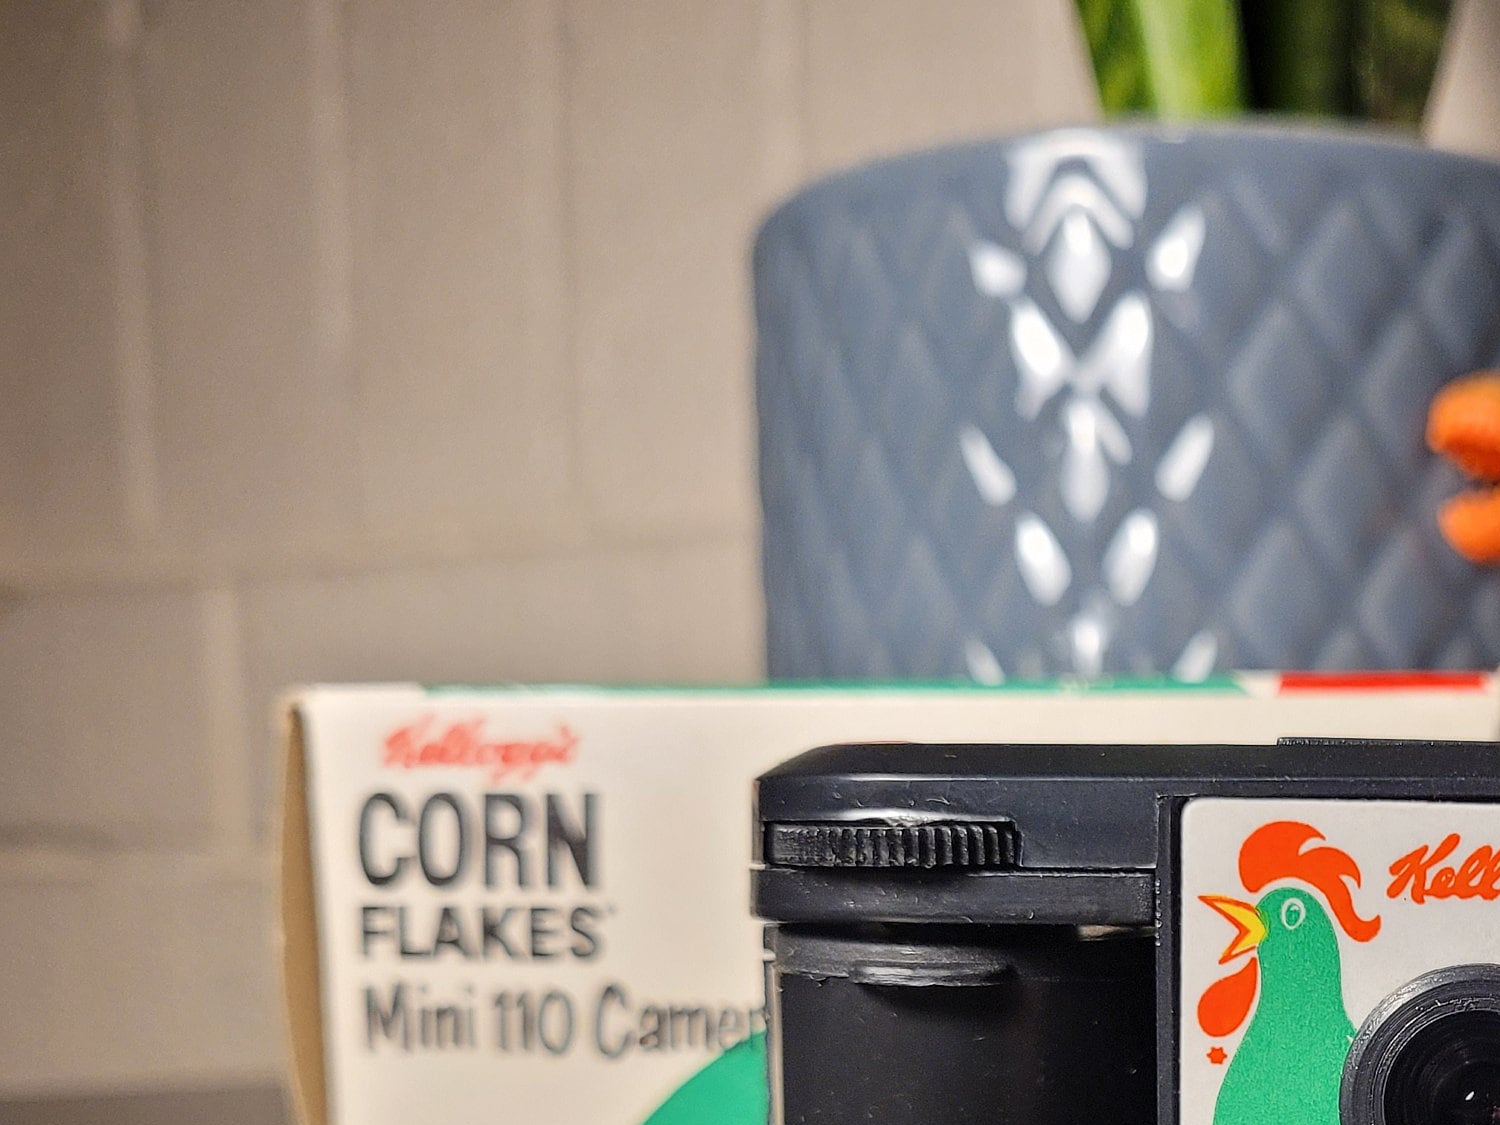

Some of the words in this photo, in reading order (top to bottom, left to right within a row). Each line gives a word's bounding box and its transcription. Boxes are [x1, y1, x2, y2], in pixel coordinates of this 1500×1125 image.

[359, 792, 600, 887] CORN
[361, 905, 601, 957] FLAKES
[364, 985, 478, 1051] Mini
[494, 990, 574, 1055] 110
[599, 983, 767, 1056] Camer
